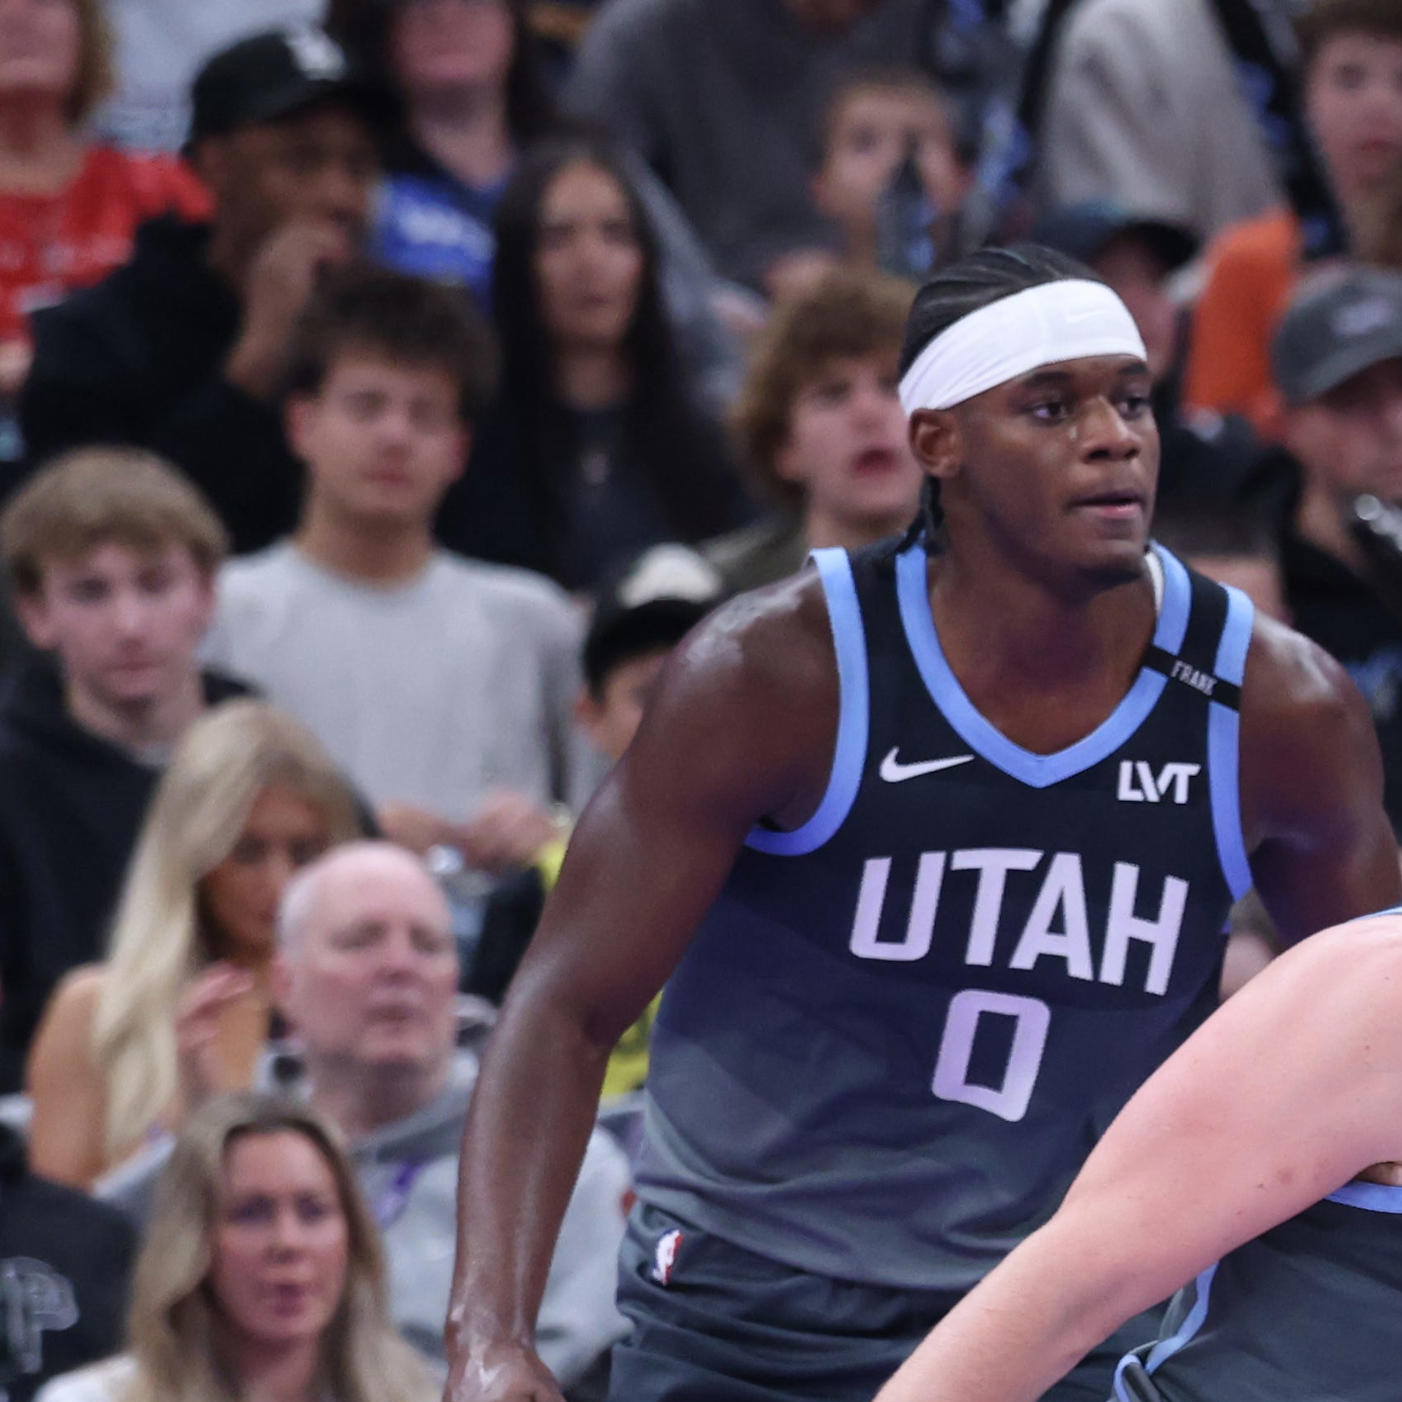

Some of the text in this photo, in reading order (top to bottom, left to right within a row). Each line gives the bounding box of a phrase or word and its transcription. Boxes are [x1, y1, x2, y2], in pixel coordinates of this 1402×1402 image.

[1170, 659, 1219, 697] FRANK
[1117, 759, 1202, 804] LVT
[849, 847, 1190, 997] UTAH
[931, 988, 1052, 1123] 0
